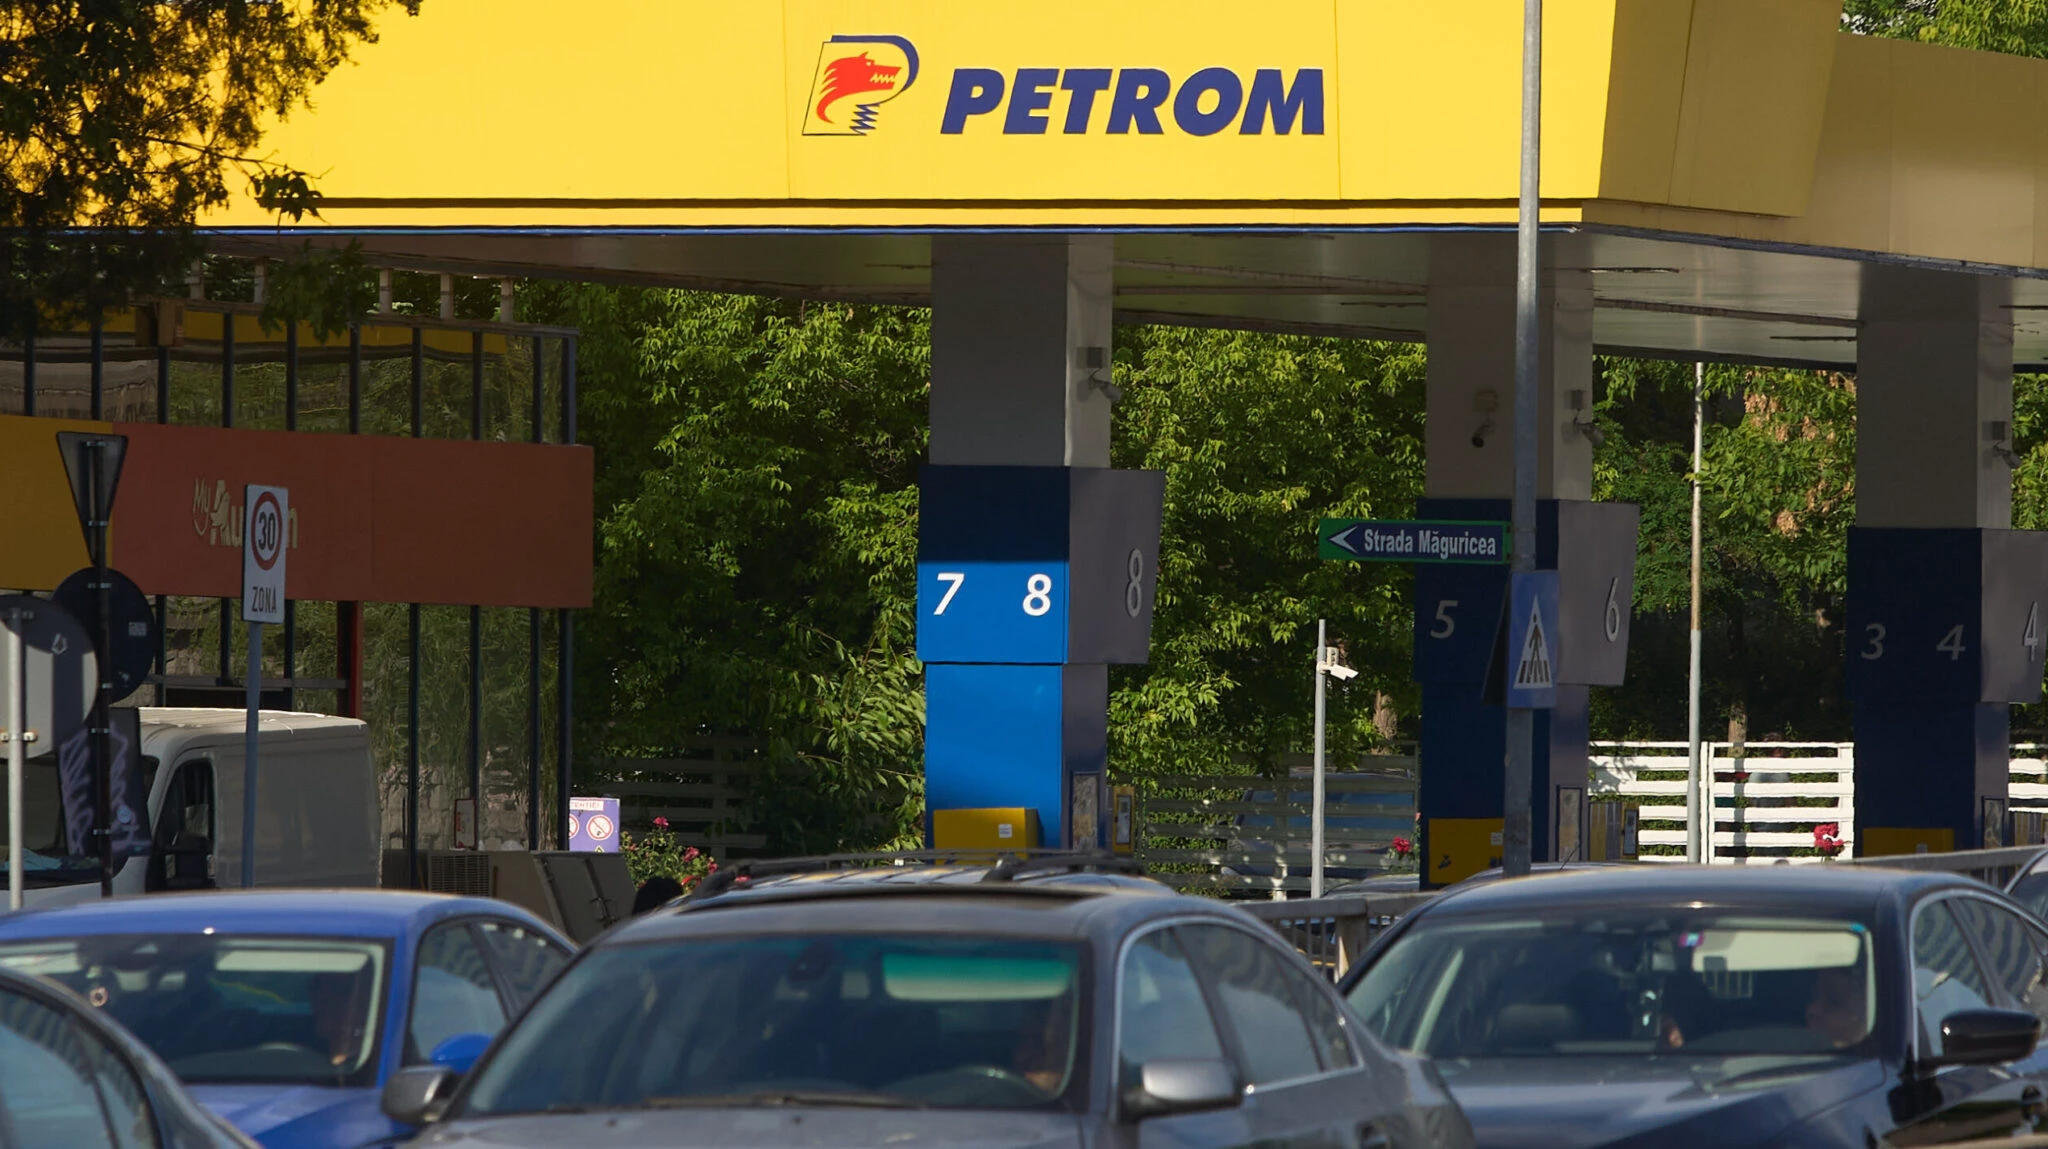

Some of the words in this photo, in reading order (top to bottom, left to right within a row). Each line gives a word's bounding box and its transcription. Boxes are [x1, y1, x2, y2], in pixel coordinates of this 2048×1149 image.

[941, 67, 1324, 137] PETROM
[193, 477, 211, 536] My
[209, 480, 298, 548] Aun
[258, 512, 276, 551] 30
[1364, 528, 1413, 553] Strada
[1418, 530, 1496, 560] Măguricea
[252, 586, 277, 613] ZONA
[933, 572, 965, 615] 7
[1022, 573, 1052, 616] 8
[1125, 548, 1143, 618] 8
[1430, 600, 1458, 639] 5
[1605, 577, 1620, 643] 6
[2023, 601, 2039, 662] 4
[1861, 623, 1887, 660] 3
[1936, 624, 1966, 661] 4
